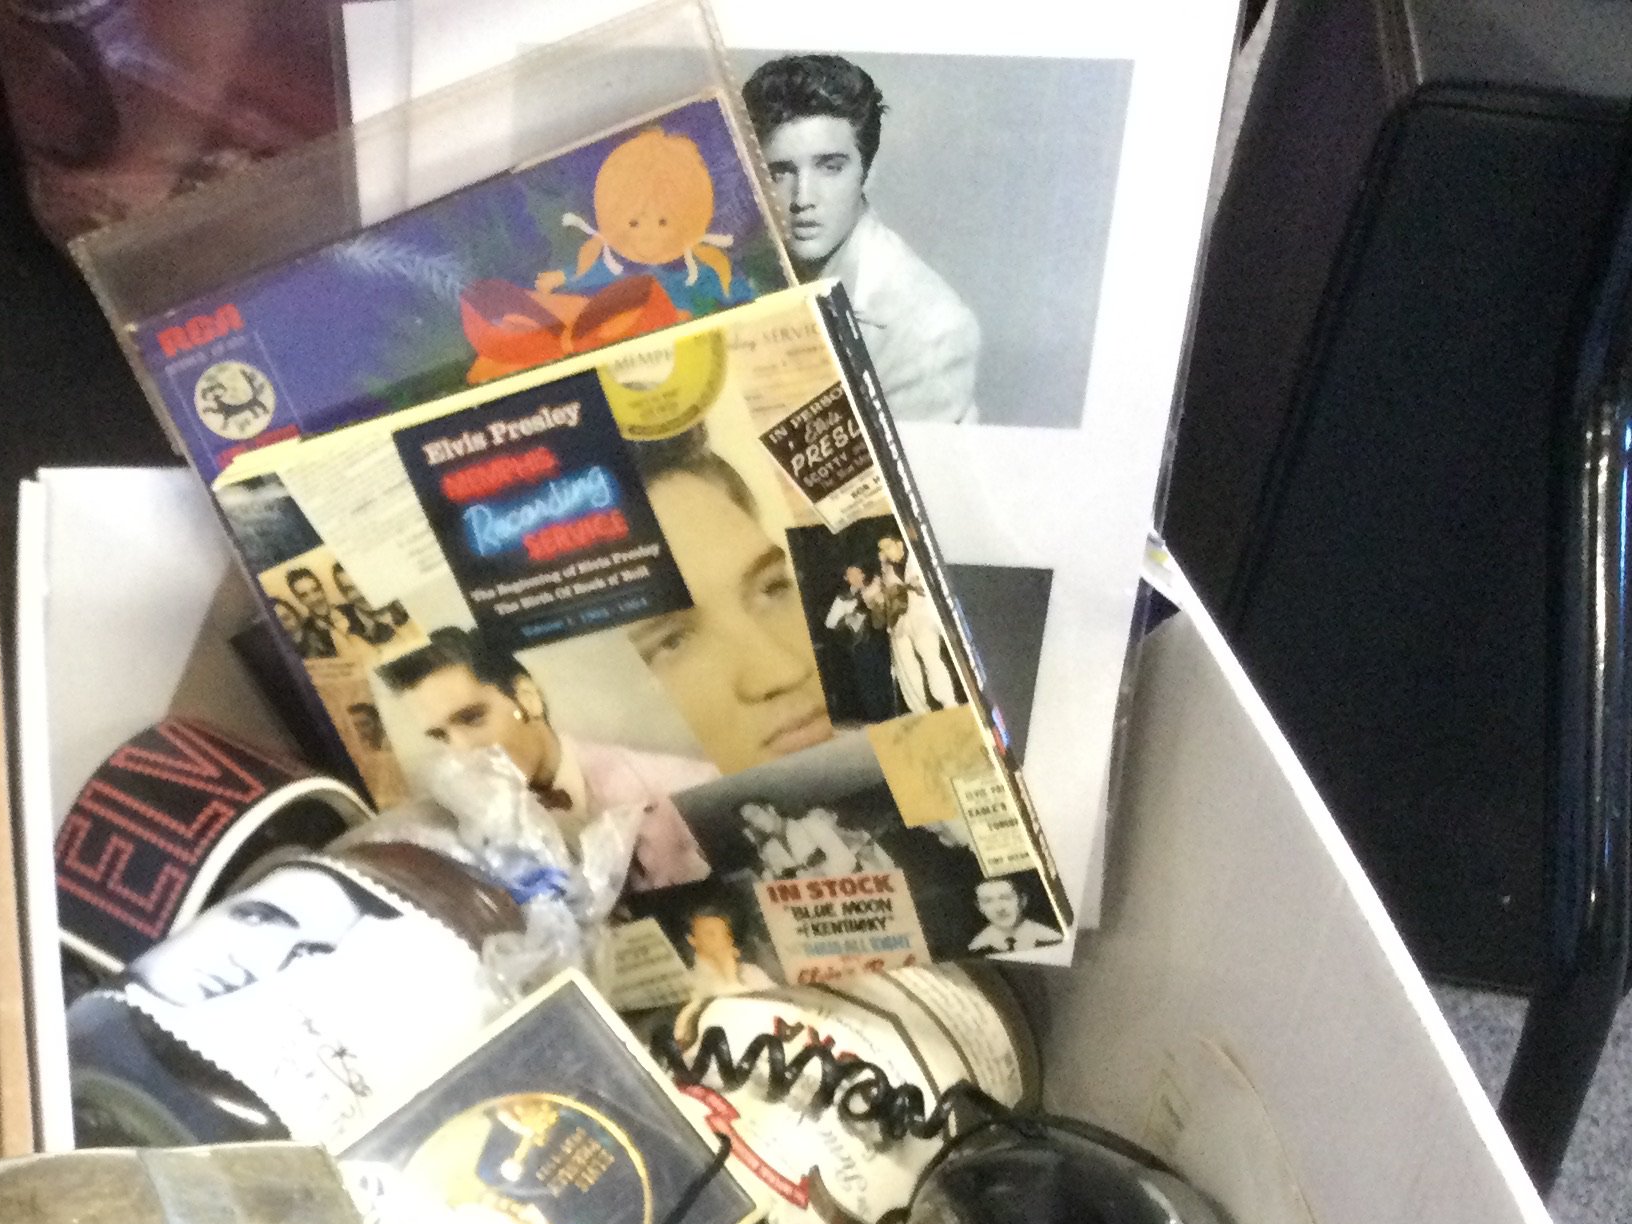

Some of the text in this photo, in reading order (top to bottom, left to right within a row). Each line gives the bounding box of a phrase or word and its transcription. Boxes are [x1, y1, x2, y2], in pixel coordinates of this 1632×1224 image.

[422, 432, 488, 466] Elvis
[486, 400, 582, 446] Presley
[769, 426, 788, 444] IN
[767, 873, 896, 904] IN STOCK
[841, 896, 894, 917] MOON
